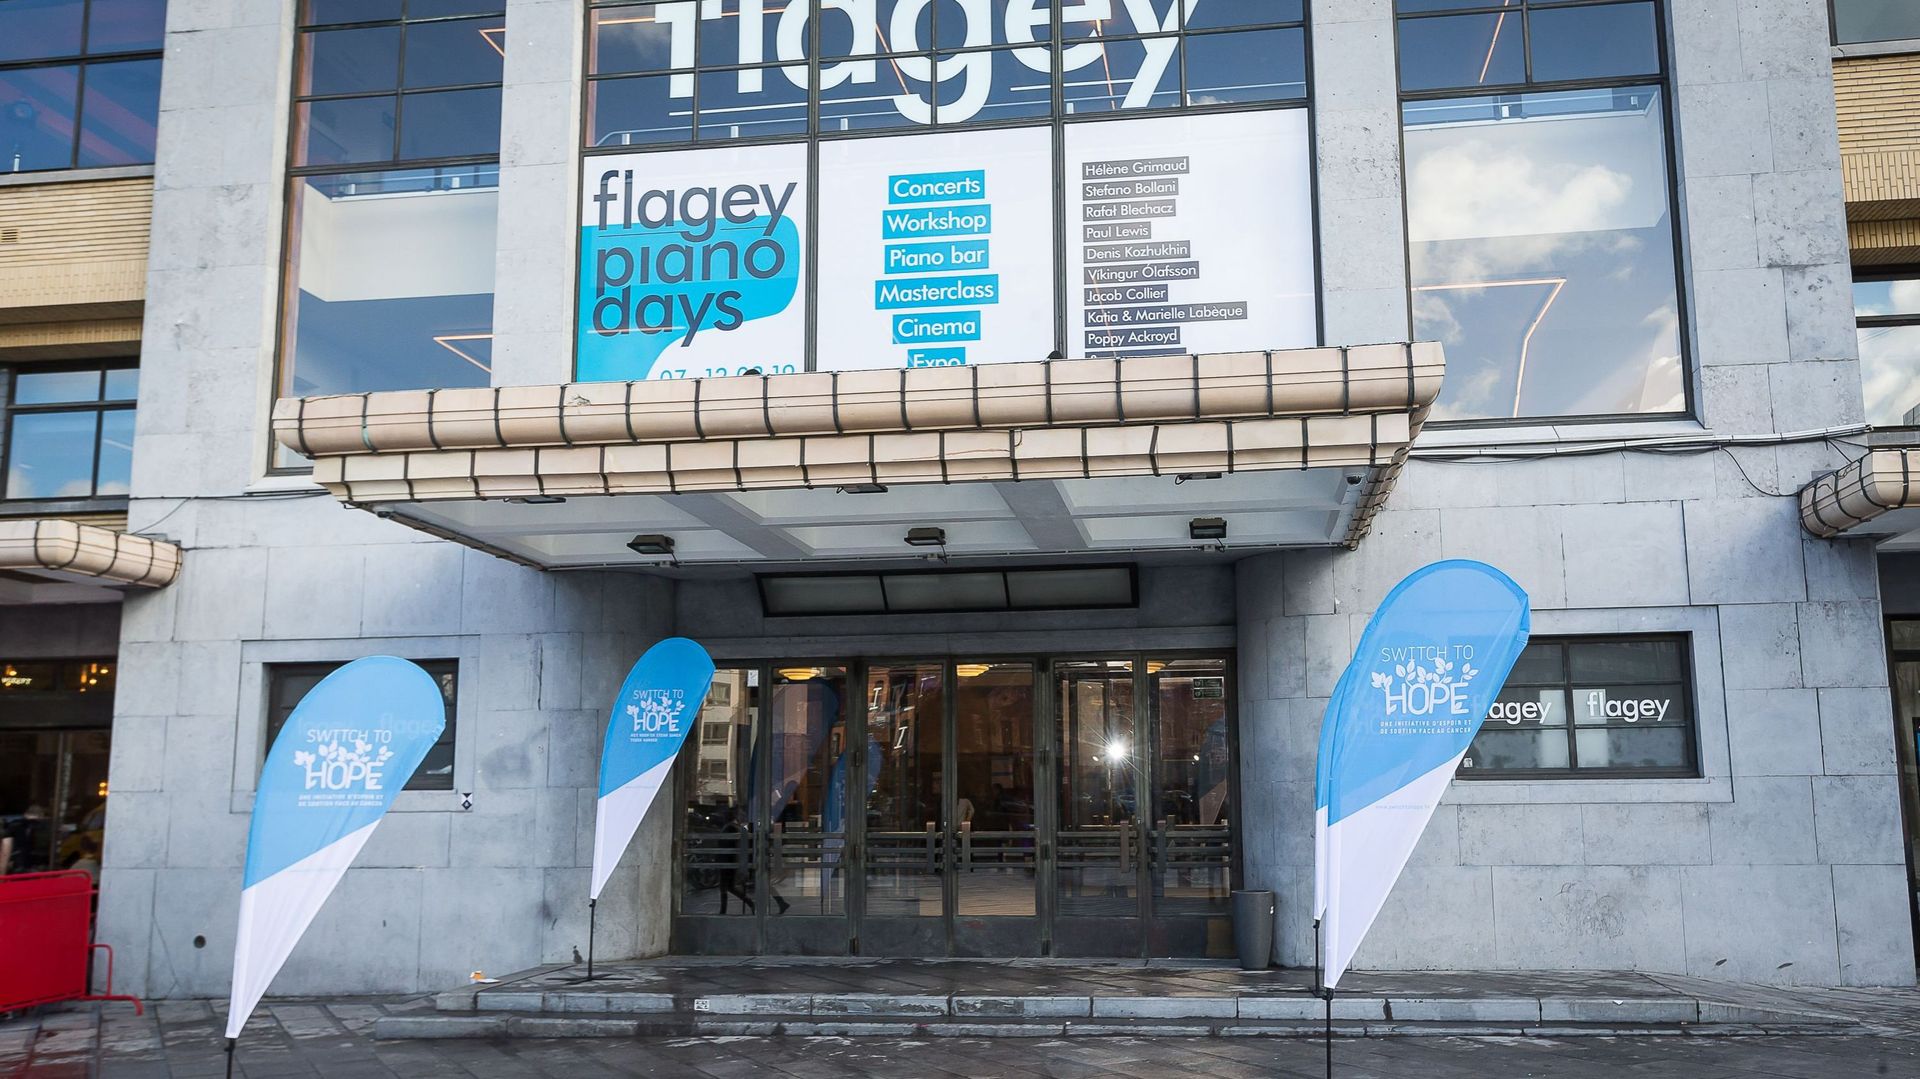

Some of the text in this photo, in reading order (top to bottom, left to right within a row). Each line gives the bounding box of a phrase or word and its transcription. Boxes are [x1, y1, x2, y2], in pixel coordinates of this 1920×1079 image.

[655, 0, 1199, 124] flagey
[1085, 159, 1187, 176] Hélène Grimaud
[894, 178, 980, 197] Concerts
[1085, 181, 1176, 197] Stefano Bollani
[593, 170, 797, 242] flagey
[1121, 203, 1174, 216] Blechacz
[887, 211, 987, 232] Workshop
[1086, 225, 1148, 239] Paul Lewis
[890, 245, 985, 267] Piano bar
[1087, 244, 1188, 260] Denis Kozhukhin
[596, 239, 785, 299] piano
[1088, 264, 1196, 281] Víkingur Ólafsson
[880, 280, 994, 303] Masterclass
[1087, 288, 1166, 302] Jacob Collier
[593, 285, 744, 347] days
[1088, 305, 1243, 323] Katia & Marielle Labèque
[898, 318, 975, 337] Cinema
[1088, 329, 1177, 346] Poppy Ackroyd
[1382, 644, 1474, 661] SWITCH TO
[633, 689, 684, 699] SWITCH TO
[1386, 682, 1469, 715] HOPE
[1484, 701, 1552, 725] agey
[1586, 692, 1670, 722] flagey
[634, 711, 680, 731] HOPE
[306, 729, 392, 743] SWITCH TO
[305, 761, 384, 790] HOPE
